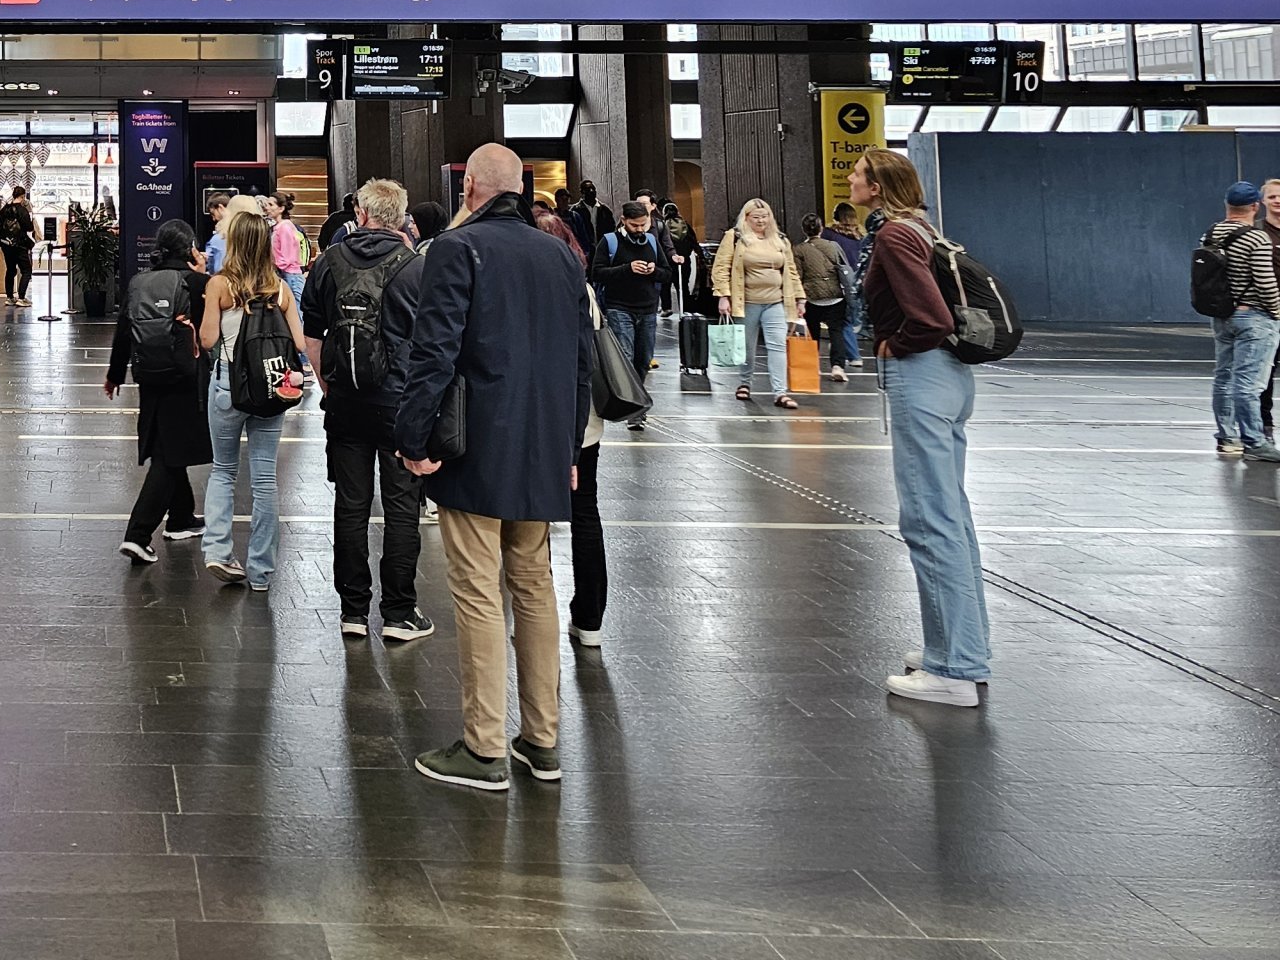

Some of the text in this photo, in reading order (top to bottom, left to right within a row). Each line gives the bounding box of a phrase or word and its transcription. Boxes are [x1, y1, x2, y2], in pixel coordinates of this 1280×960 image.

[316, 50, 333, 58] Spor
[1016, 51, 1035, 60] Spor
[316, 56, 336, 65] Track
[354, 54, 444, 64] Lillestrøm 17:11
[903, 56, 918, 65] Ski
[1016, 58, 1038, 67] Track
[424, 66, 444, 74] 17:13
[318, 70, 332, 89] 9
[1012, 72, 1039, 92] 10
[149, 158, 159, 167] SJ
[830, 158, 852, 170] for
[136, 183, 172, 192] GoAhead
